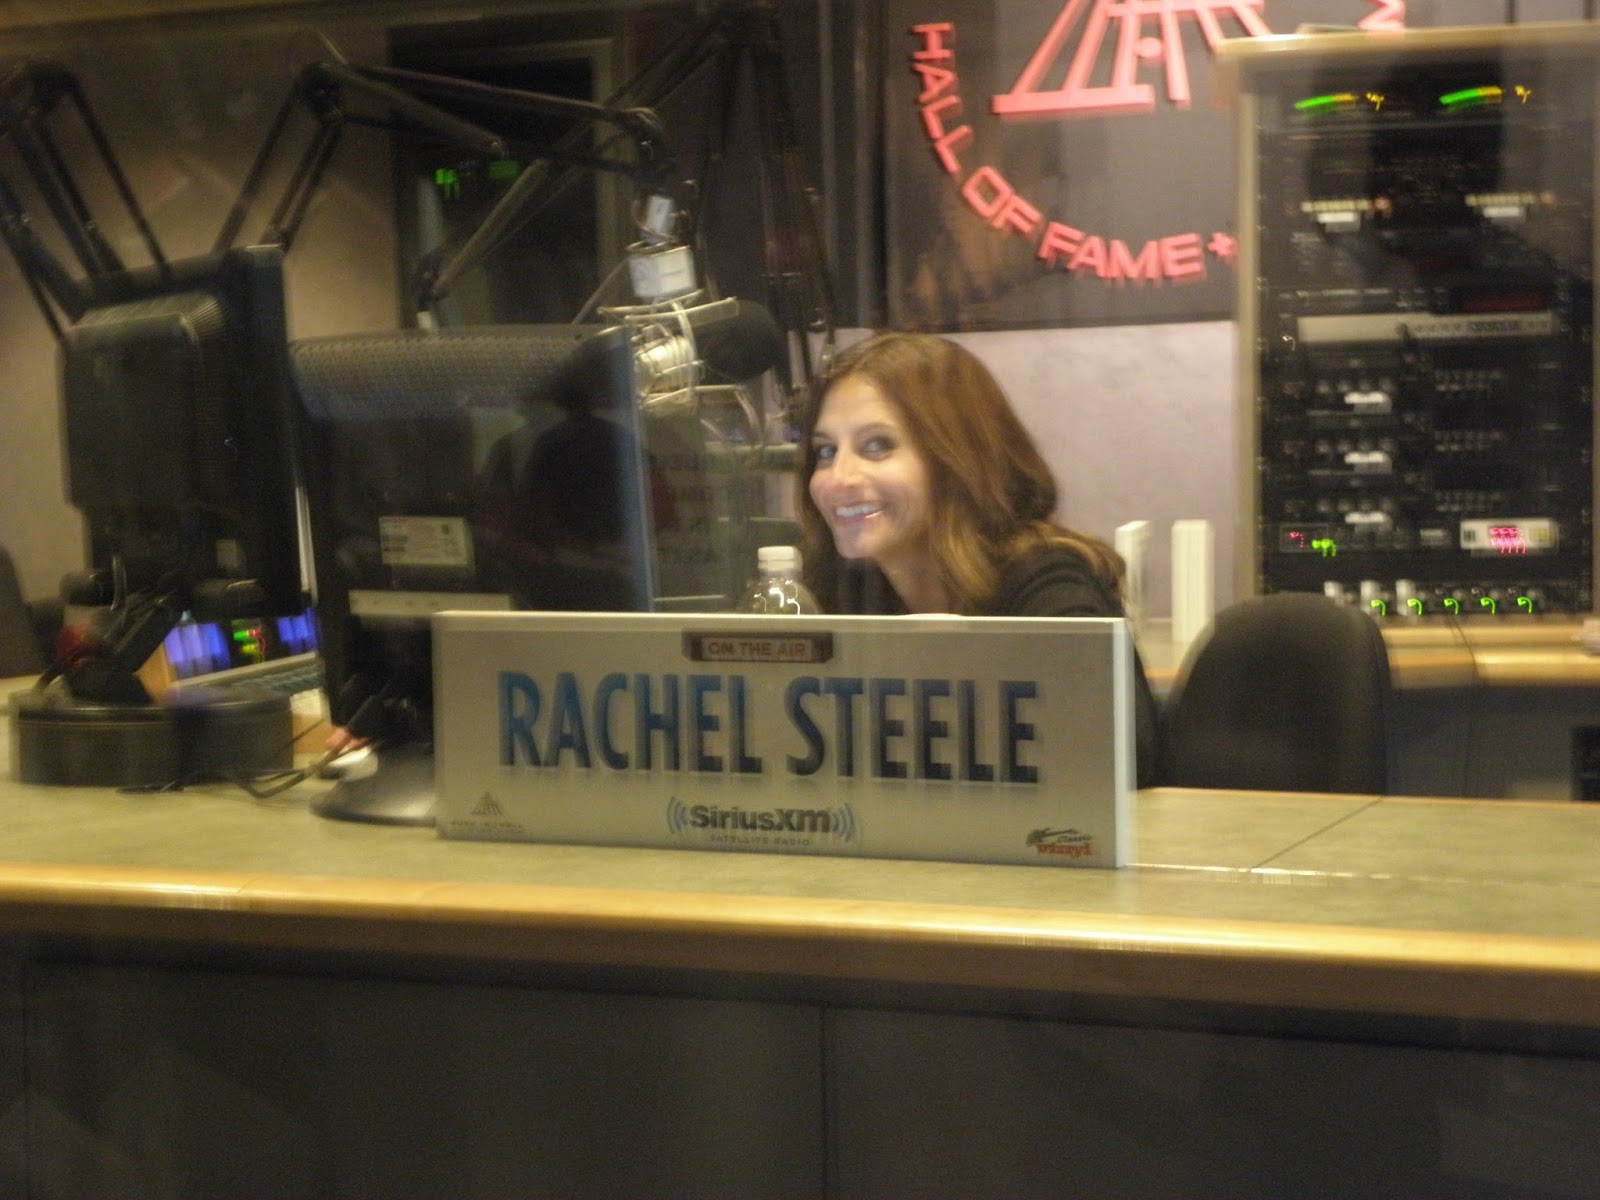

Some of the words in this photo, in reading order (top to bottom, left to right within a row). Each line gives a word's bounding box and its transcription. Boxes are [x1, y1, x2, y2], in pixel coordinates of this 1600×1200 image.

[911, 22, 973, 174] HALL
[962, 165, 1044, 236] OF
[1039, 221, 1205, 281] FAME
[708, 642, 734, 656] ON
[738, 642, 772, 656] THE
[777, 643, 806, 657] AIR
[498, 671, 763, 774] RACHEL
[784, 675, 1039, 784] STEELE
